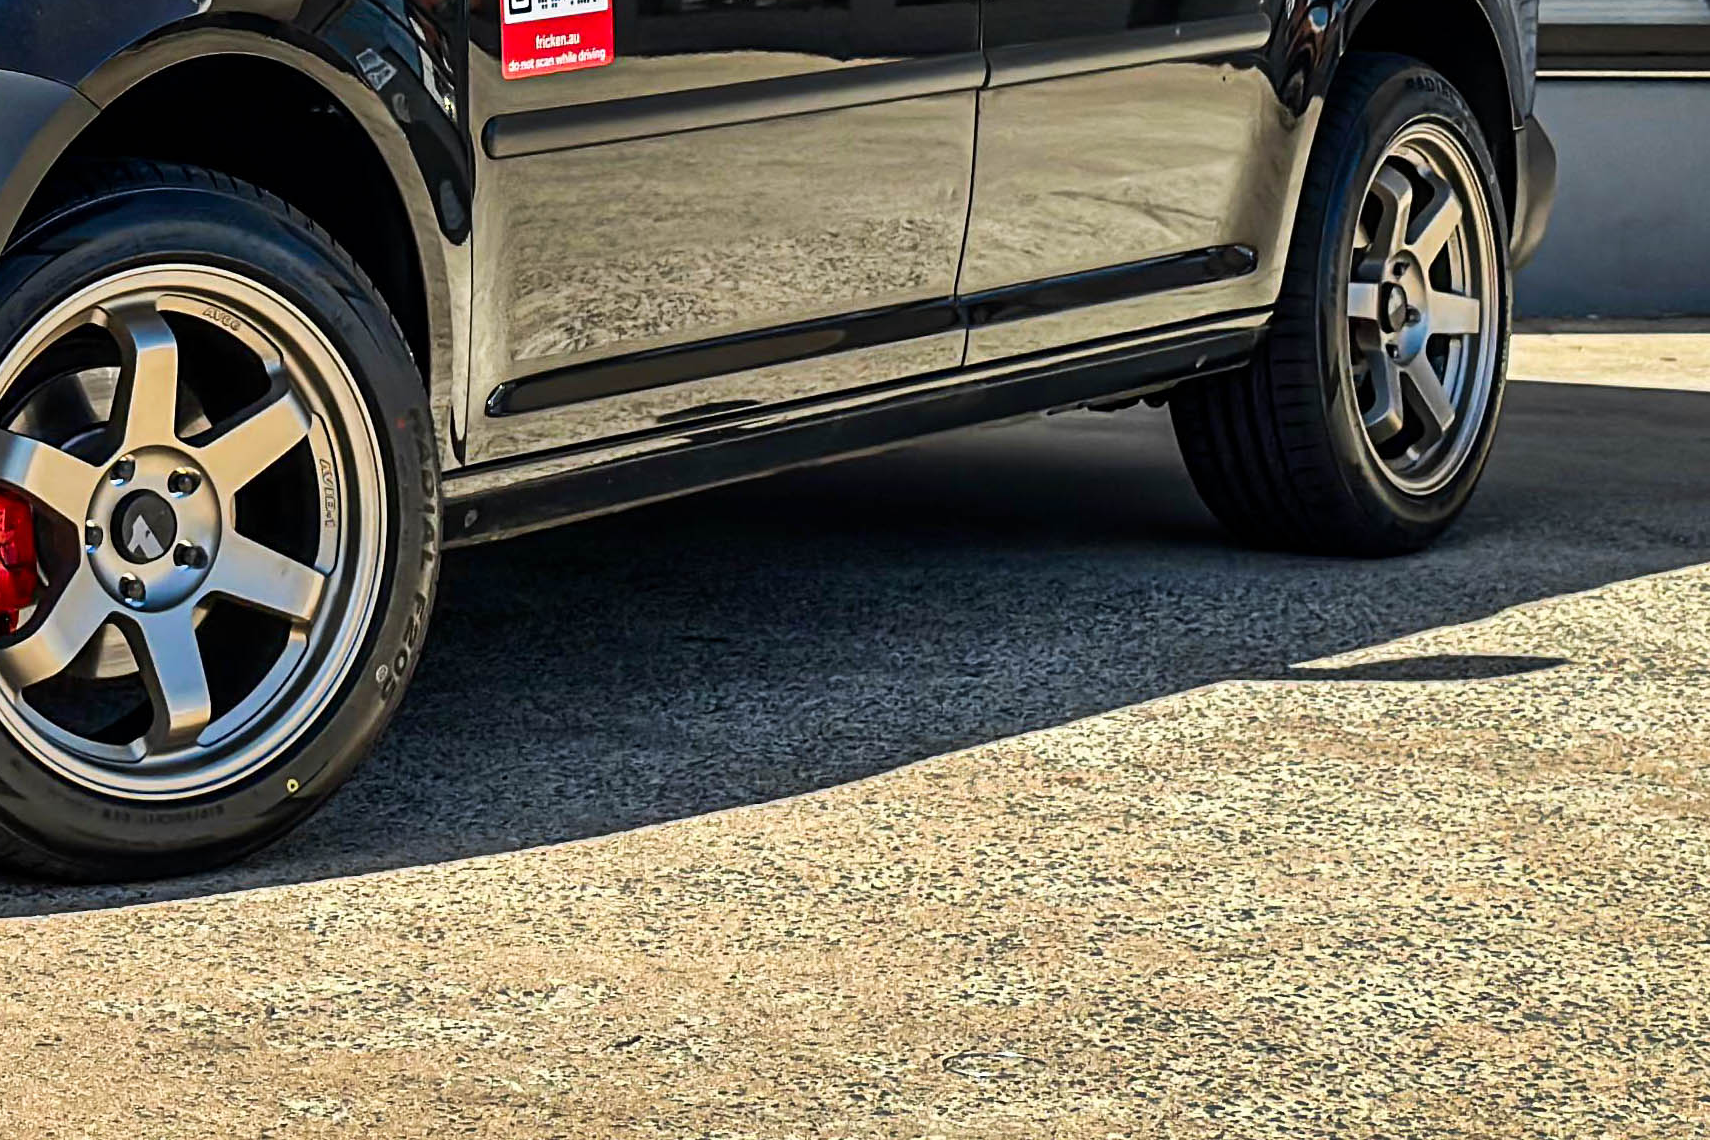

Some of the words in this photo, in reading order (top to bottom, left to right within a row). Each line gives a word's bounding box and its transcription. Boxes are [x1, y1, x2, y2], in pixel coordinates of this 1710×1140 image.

[535, 33, 580, 50] fricken.au
[508, 59, 519, 72] do
[555, 51, 577, 64] while
[578, 47, 606, 61] driving
